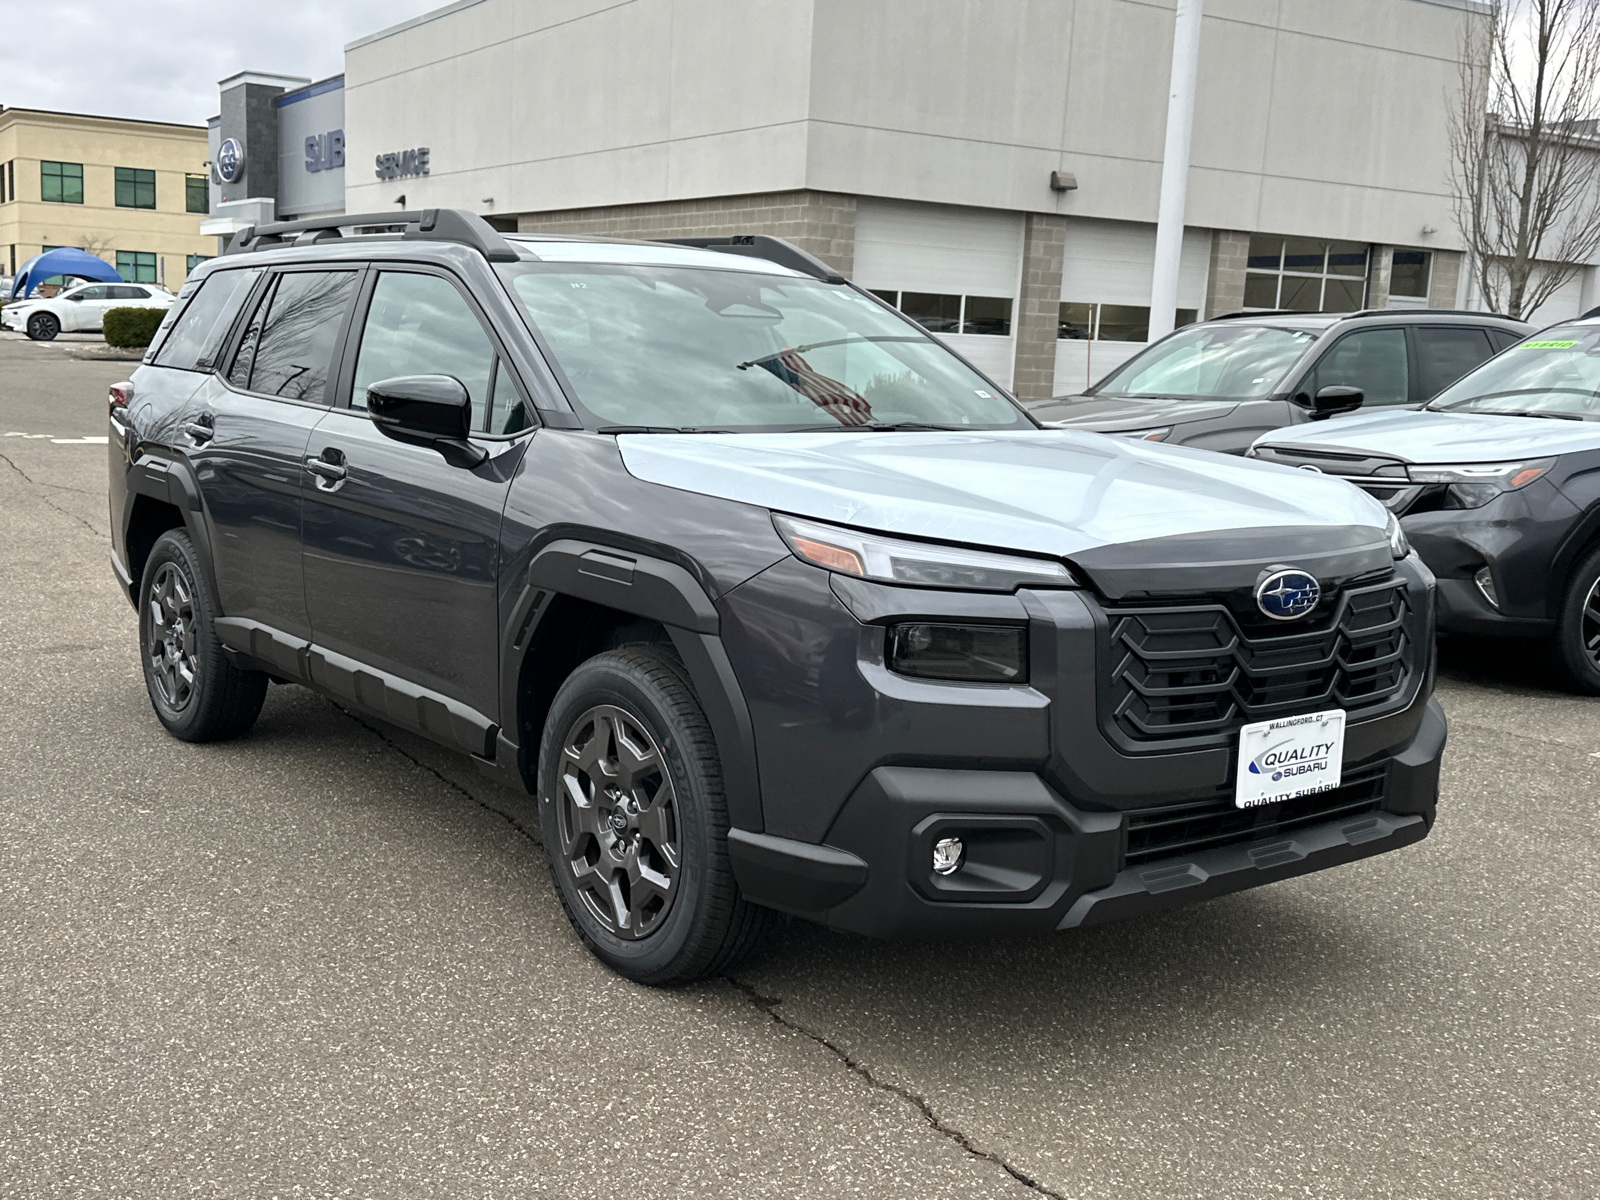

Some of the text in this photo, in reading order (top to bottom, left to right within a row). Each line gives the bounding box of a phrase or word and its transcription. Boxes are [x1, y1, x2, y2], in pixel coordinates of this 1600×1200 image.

[375, 147, 430, 180] SERVICE
[1315, 714, 1324, 723] CT
[1265, 742, 1335, 766] QUALITY
[1283, 761, 1328, 778] SUBARU
[1244, 782, 1338, 808] QUALITY SUBARU
